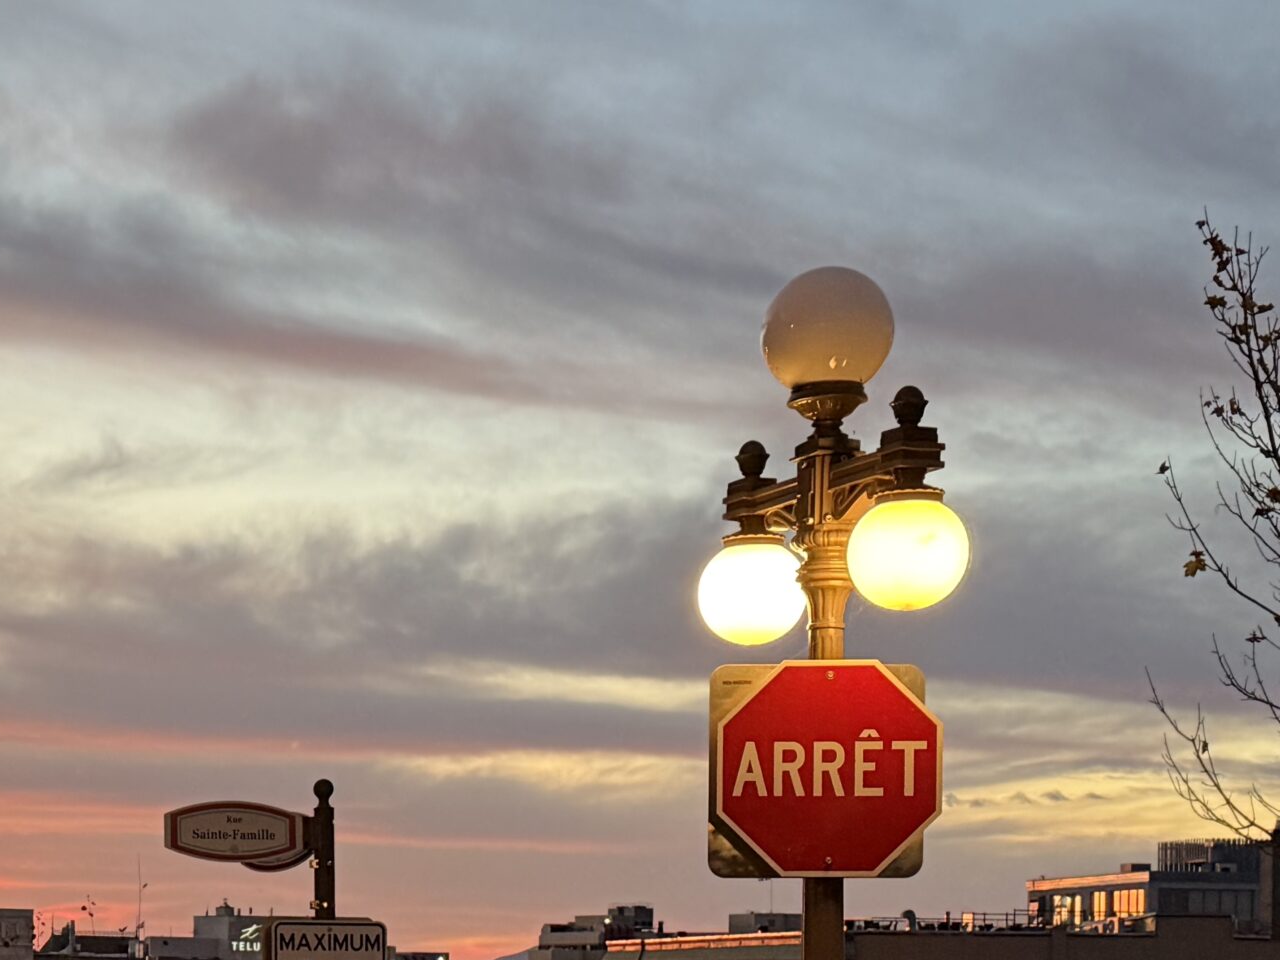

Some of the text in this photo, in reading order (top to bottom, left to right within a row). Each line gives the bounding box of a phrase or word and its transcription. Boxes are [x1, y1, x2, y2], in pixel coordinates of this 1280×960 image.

[732, 728, 928, 797] ARRÊT
[192, 828, 276, 841] Sainte-Famille
[231, 941, 261, 951] TELU
[279, 932, 381, 952] MAXIMUM
